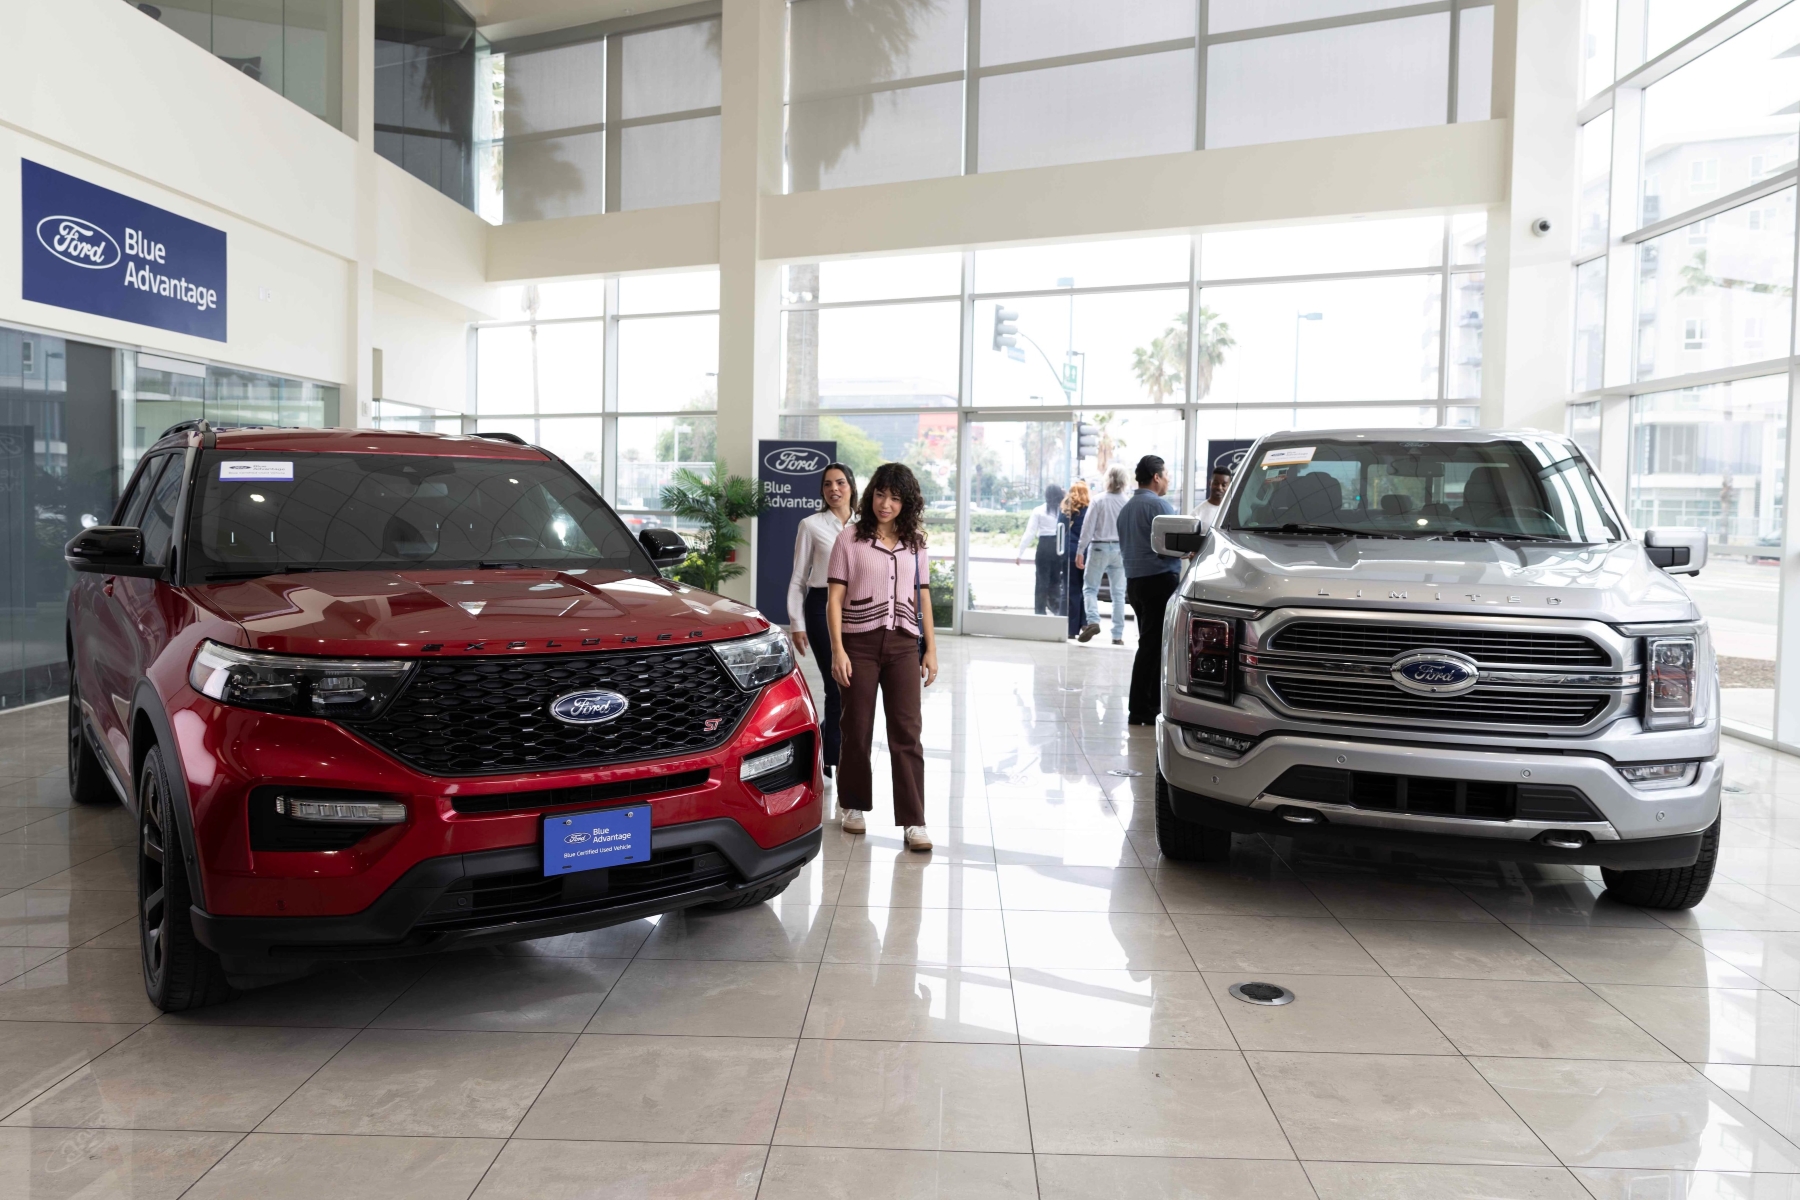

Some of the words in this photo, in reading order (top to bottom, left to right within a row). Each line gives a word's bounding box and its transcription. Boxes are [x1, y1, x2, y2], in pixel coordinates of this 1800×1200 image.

[53, 221, 106, 263] Ford
[124, 227, 166, 264] Blue
[124, 261, 217, 311] Advantage
[775, 450, 819, 471] Ford
[763, 481, 792, 494] Blue
[763, 494, 825, 511] Advantag
[1317, 588, 1562, 605] LIMITED
[421, 630, 703, 650] EXPLORER
[1413, 663, 1455, 683] Ford
[570, 697, 611, 717] Ford
[703, 718, 723, 732] ST
[593, 833, 631, 843] Advantage
[576, 848, 599, 857] Certified
